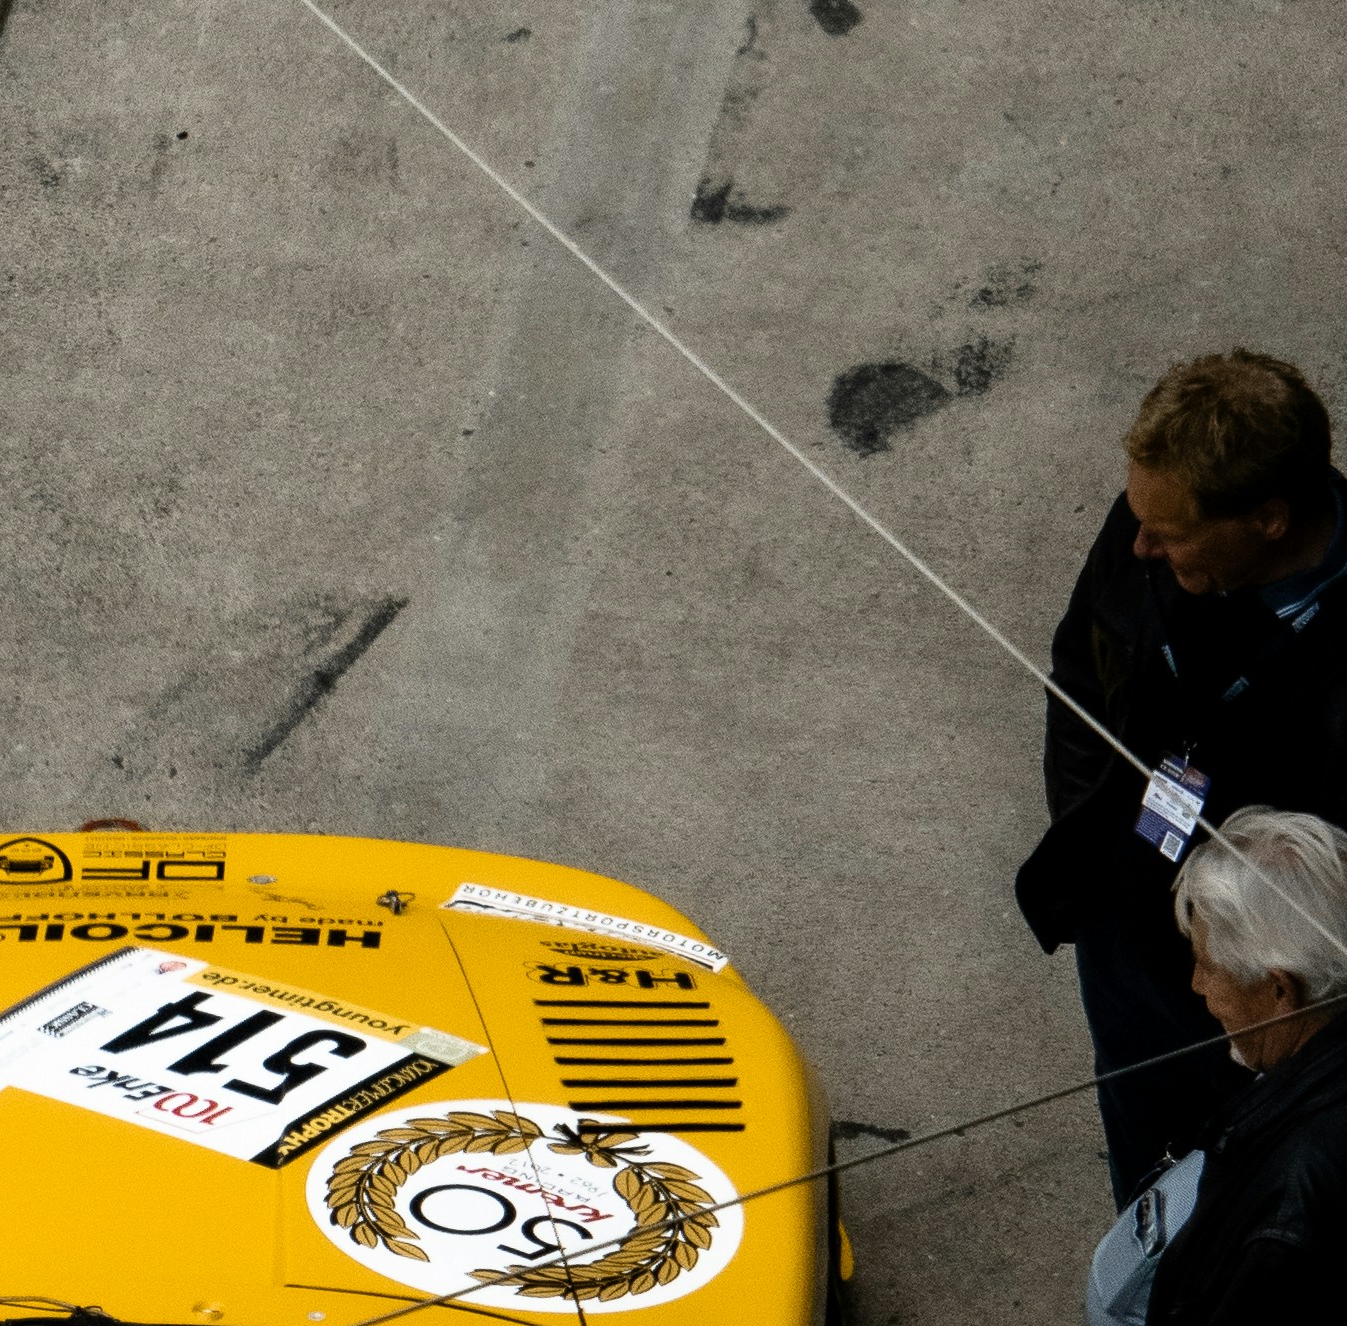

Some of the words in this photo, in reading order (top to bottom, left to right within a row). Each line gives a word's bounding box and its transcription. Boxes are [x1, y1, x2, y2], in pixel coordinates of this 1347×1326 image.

[287, 914, 383, 927] made
[200, 968, 411, 1037] youngtimer.de
[532, 963, 695, 991] H&R
[99, 990, 368, 1106] 514
[68, 1063, 167, 1103] Enke
[409, 1184, 594, 1261] 50
[455, 1164, 615, 1224] kremer
